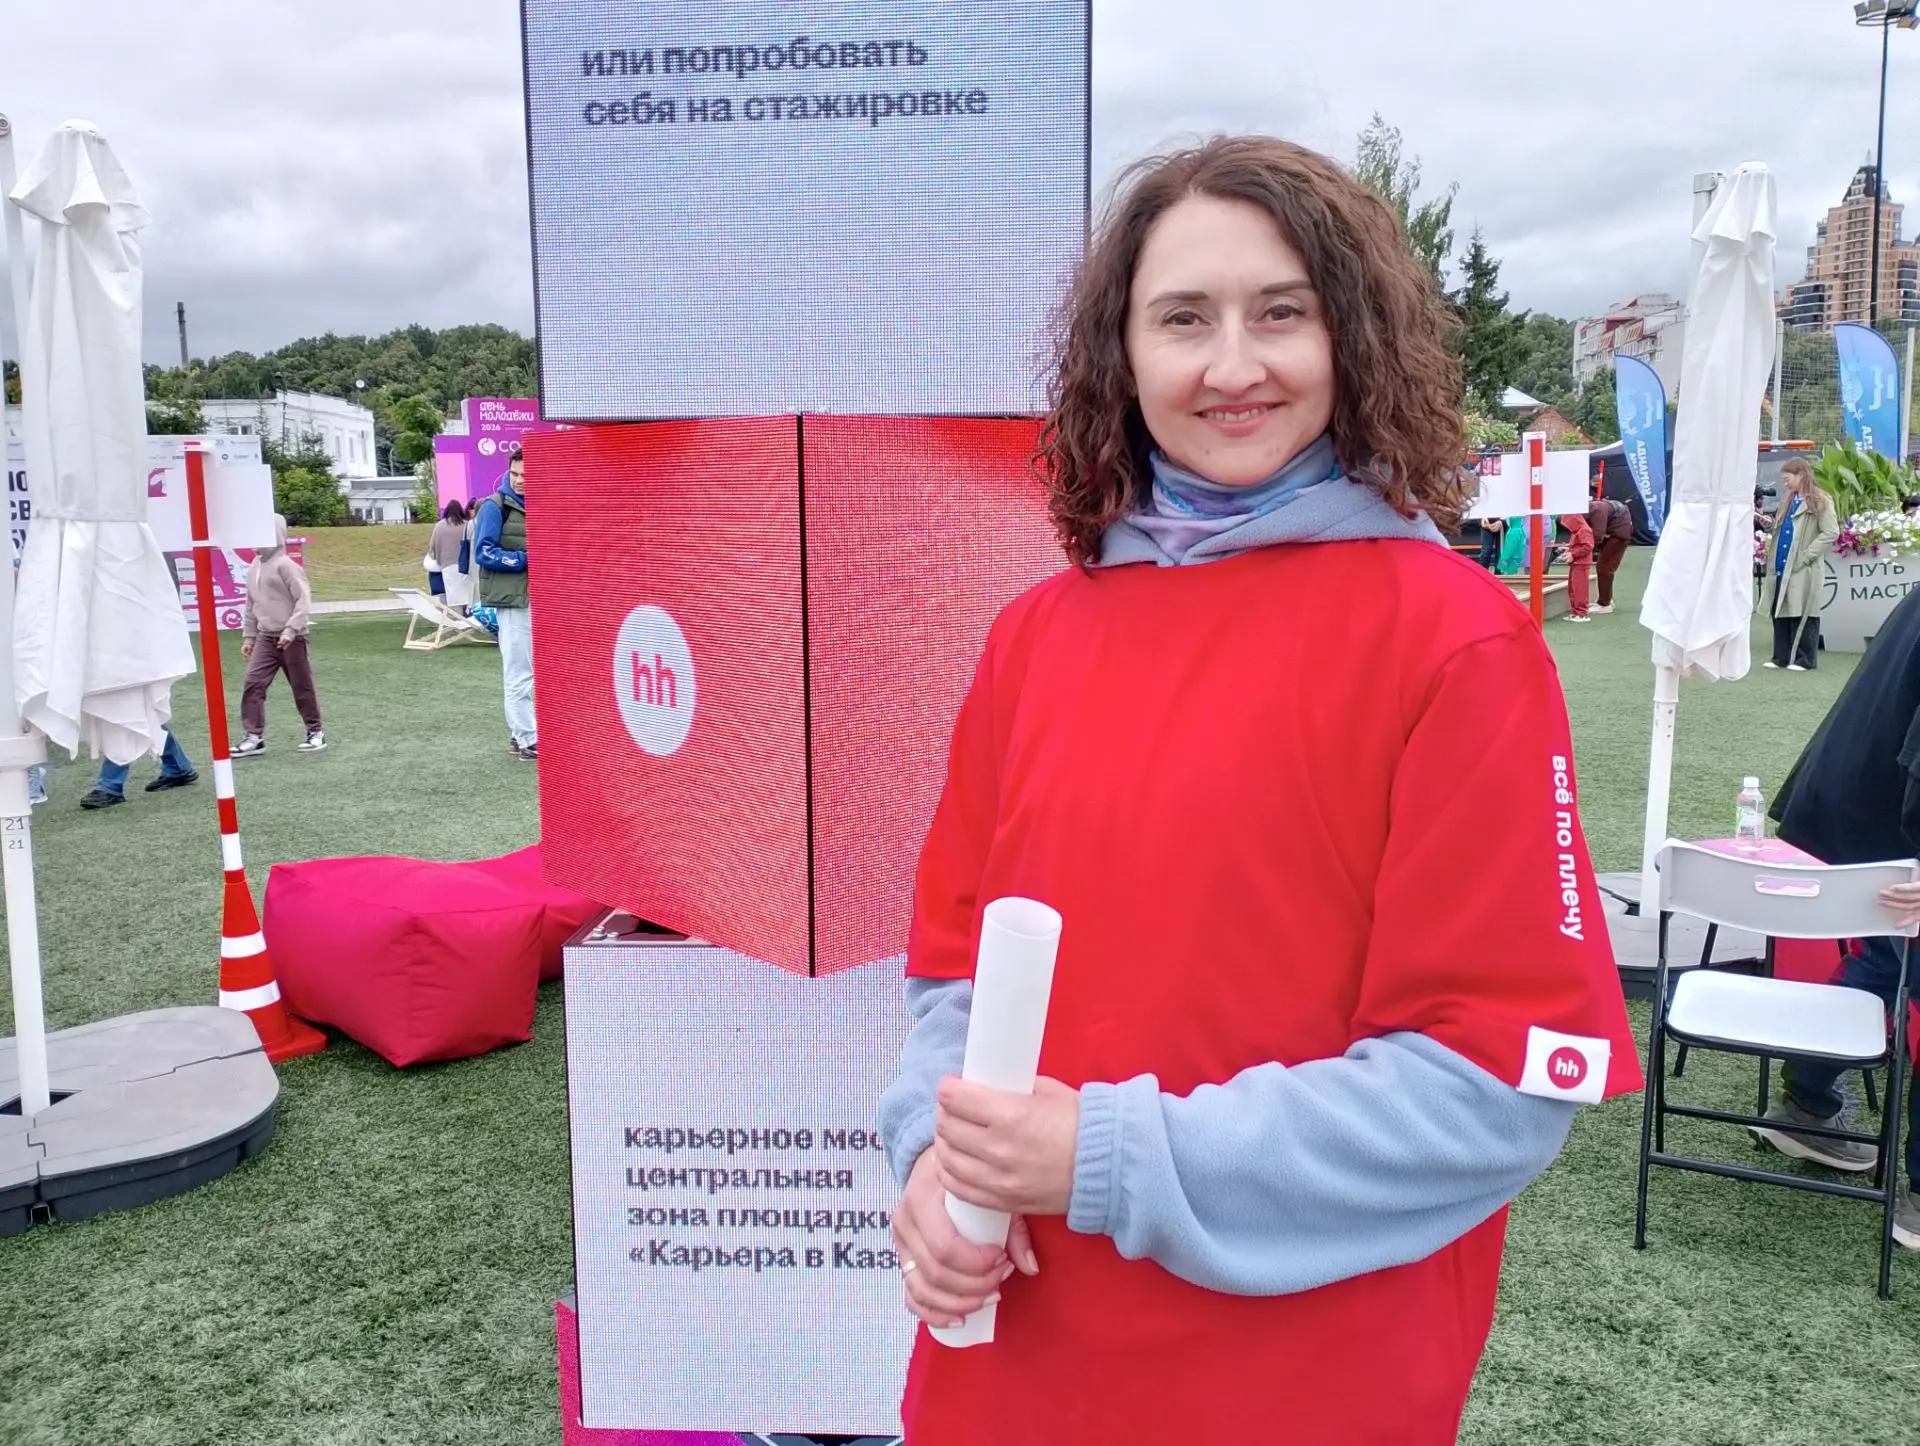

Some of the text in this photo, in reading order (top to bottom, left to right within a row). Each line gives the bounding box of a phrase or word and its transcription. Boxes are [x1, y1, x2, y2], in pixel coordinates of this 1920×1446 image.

[582, 36, 929, 79] или попробовать
[583, 88, 988, 127] себя на стажировке
[481, 423, 501, 431] 2026
[1850, 563, 1904, 578] ПУТЬ
[632, 650, 676, 708] hh
[6, 816, 24, 830] 21
[9, 839, 24, 849] 21
[1552, 755, 1584, 940] всё по плечу
[1555, 1056, 1579, 1078] hh
[624, 1127, 813, 1155] карьерное
[626, 1168, 853, 1194] центральная
[628, 1207, 709, 1226] зона
[629, 1240, 901, 1272] «Карьера в Каз
